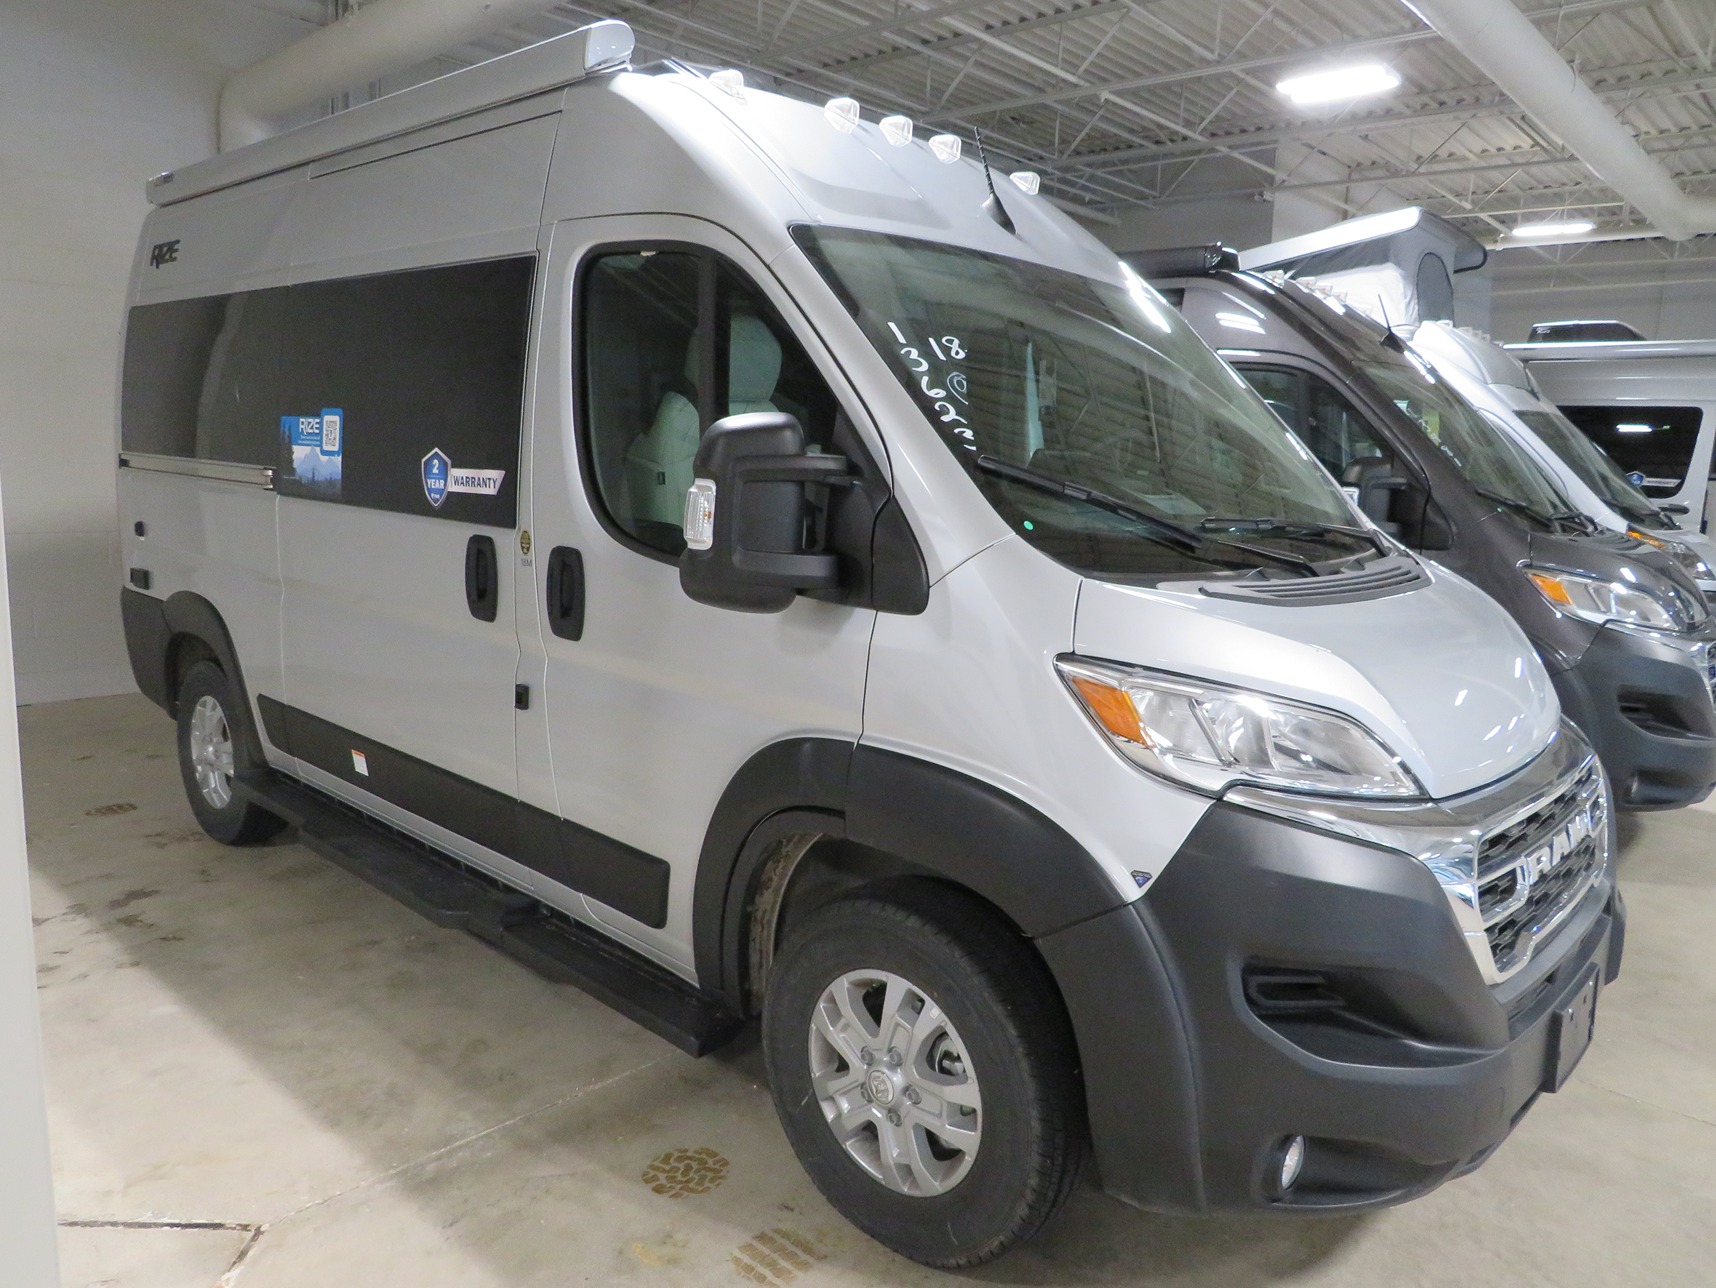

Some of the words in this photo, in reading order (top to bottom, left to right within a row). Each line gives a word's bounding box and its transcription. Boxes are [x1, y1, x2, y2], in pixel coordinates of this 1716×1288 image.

[299, 418, 320, 435] RIZE
[432, 459, 440, 474] 2
[427, 478, 445, 490] YEAR
[453, 475, 498, 489] WARRANTY
[1526, 811, 1590, 886] RAM
